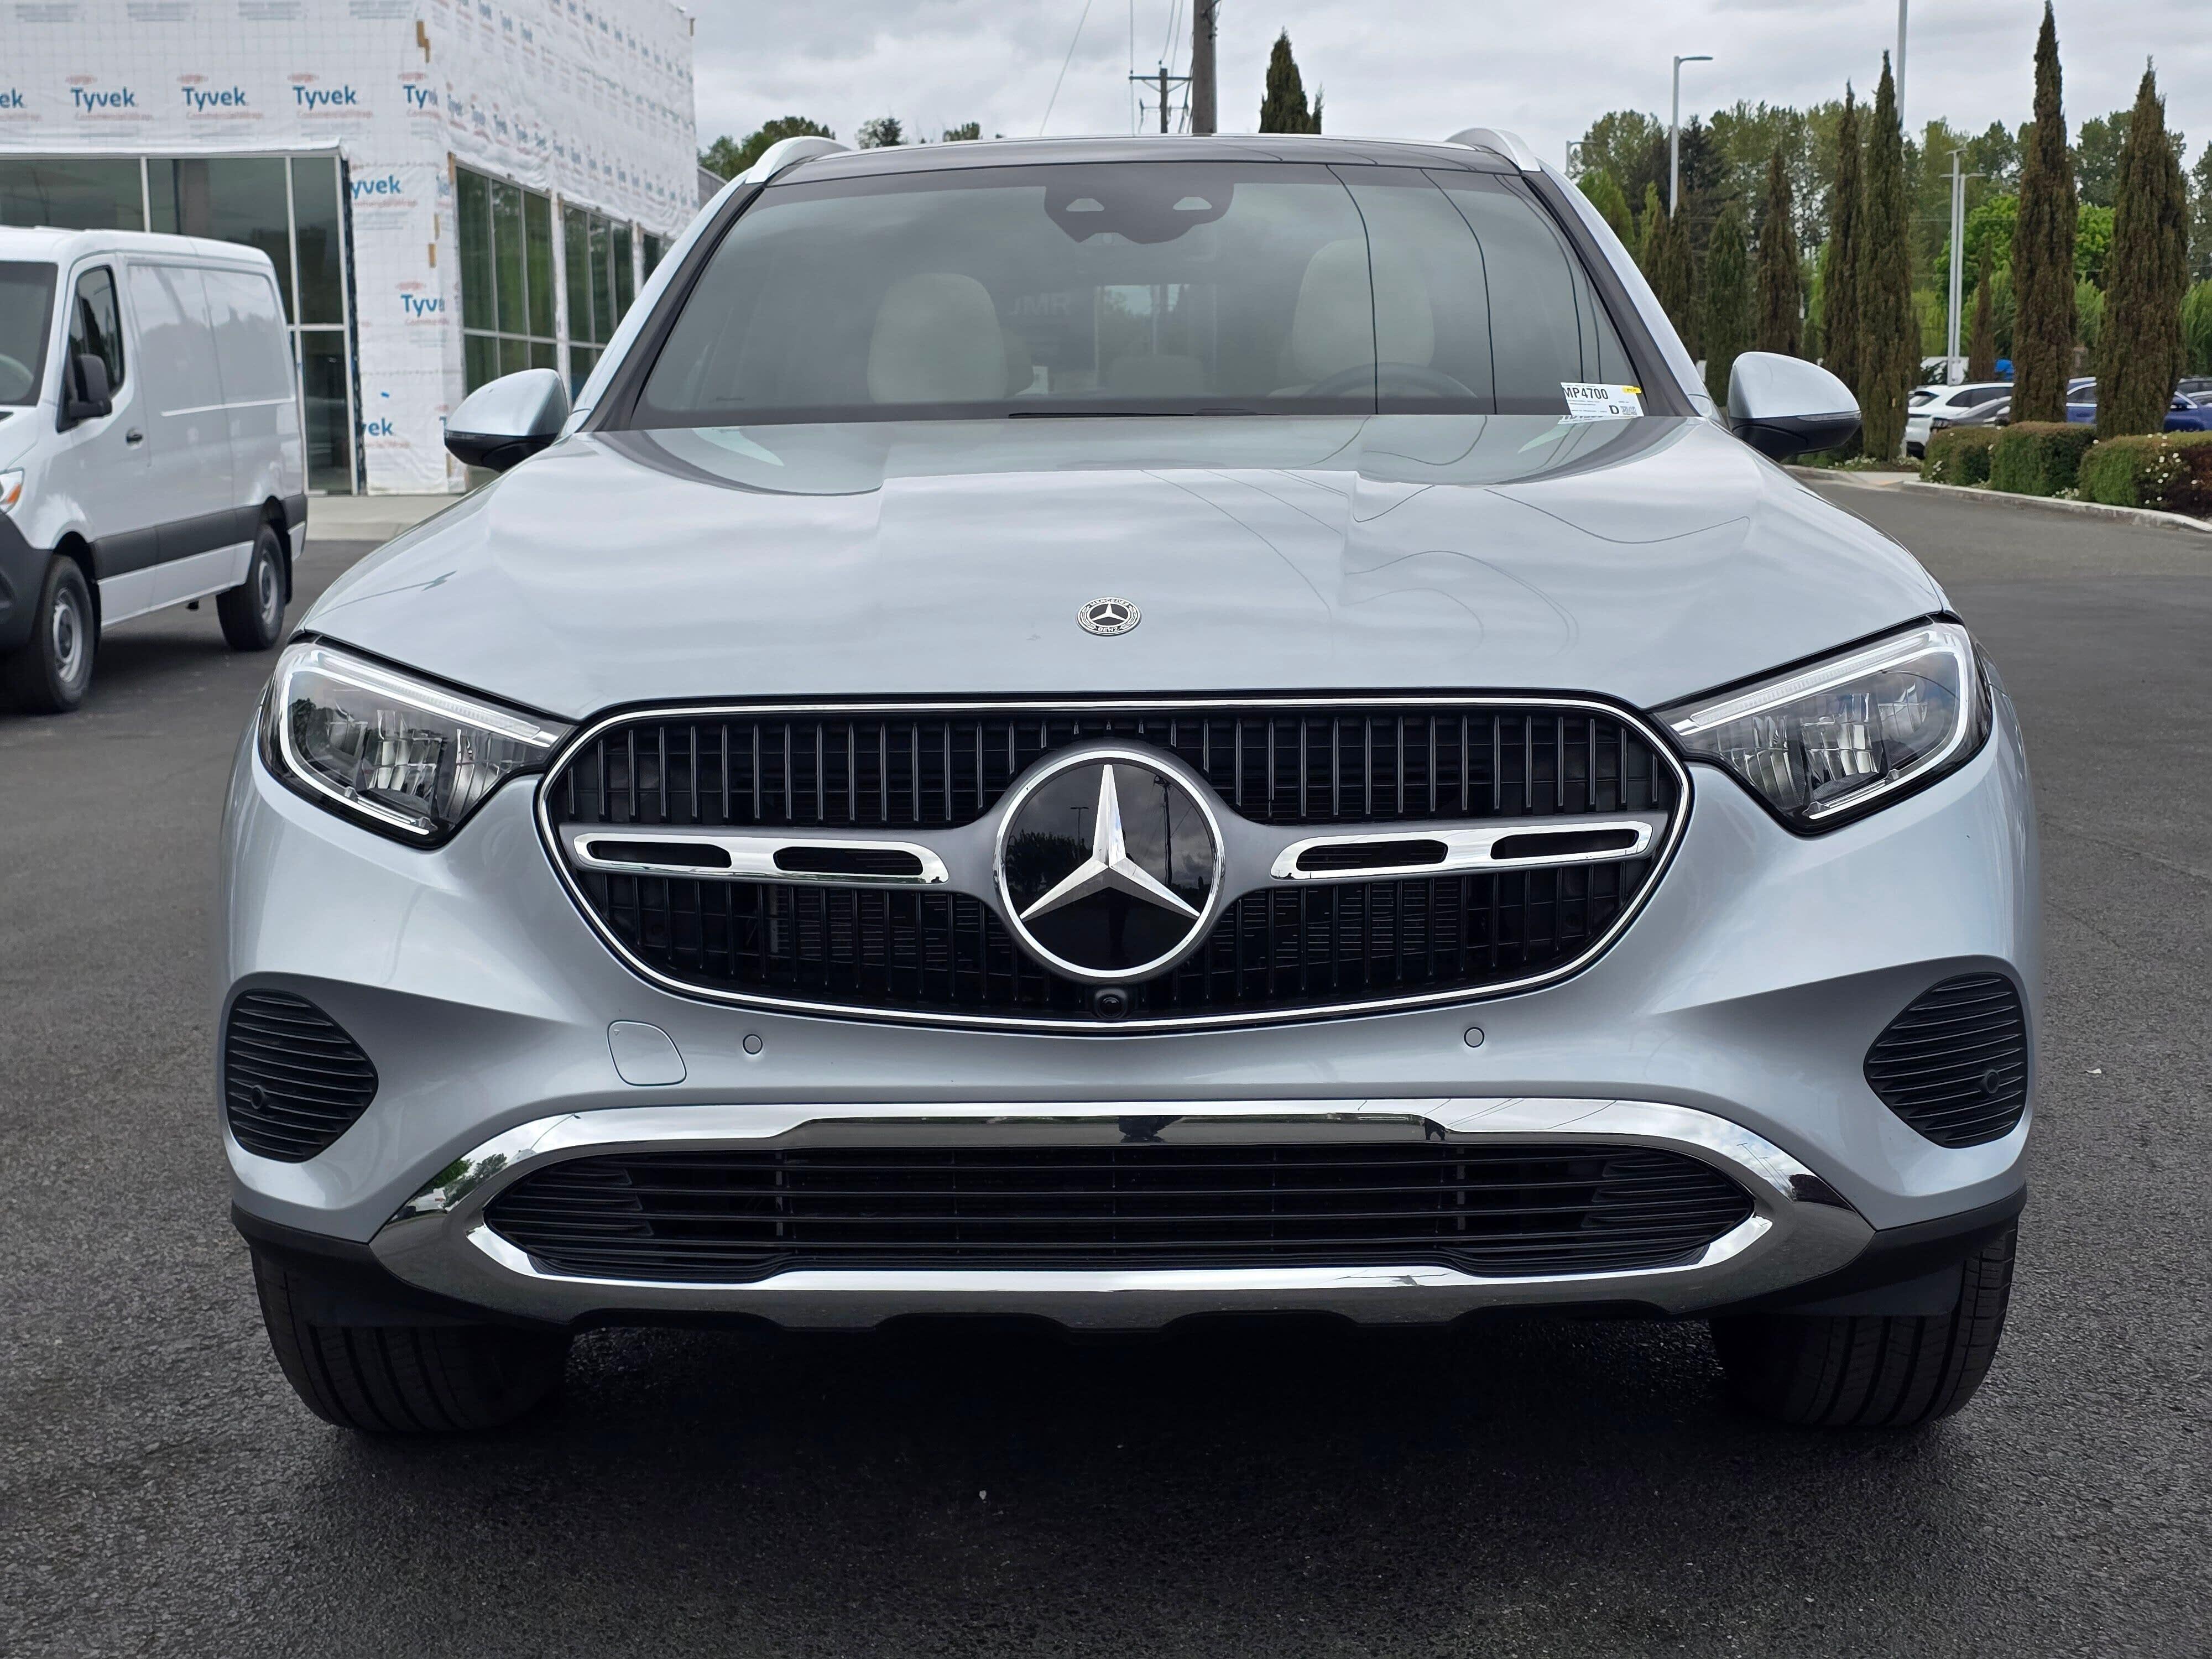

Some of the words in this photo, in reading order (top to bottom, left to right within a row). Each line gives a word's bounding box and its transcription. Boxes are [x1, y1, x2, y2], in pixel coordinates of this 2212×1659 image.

[71, 87, 135, 113] Tyvek
[181, 86, 246, 112] Tyvek
[293, 85, 357, 111] Tyvek
[1609, 405, 1620, 414] D
